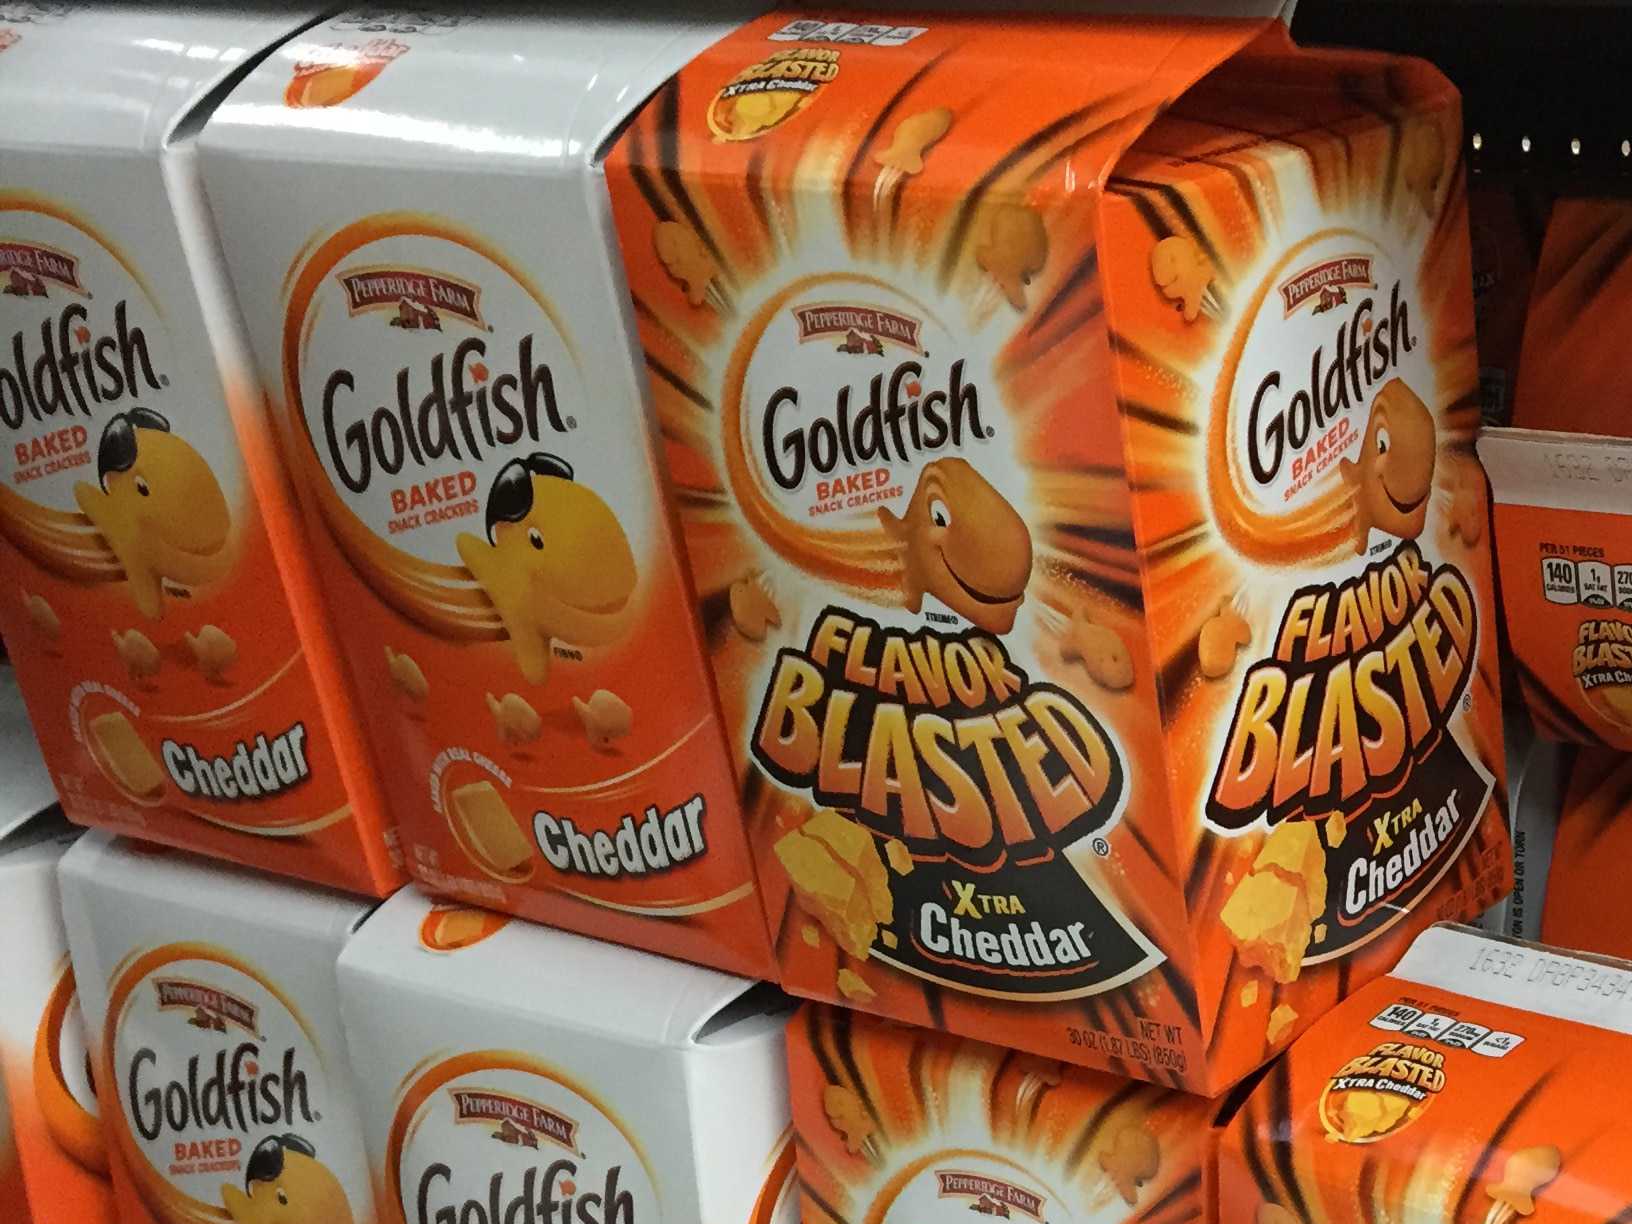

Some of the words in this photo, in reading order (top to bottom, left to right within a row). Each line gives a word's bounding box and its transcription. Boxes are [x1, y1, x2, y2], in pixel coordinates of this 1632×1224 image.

[430, 284, 470, 311] FARM
[0, 300, 161, 430] oldfish
[14, 425, 88, 465] BAKED
[1291, 417, 1350, 481] BAKED
[390, 471, 477, 513] BAKED
[816, 468, 890, 501] BAKED
[1547, 562, 1572, 584] 140
[1278, 551, 1429, 663] FLAVOR
[810, 613, 1022, 708] FLAVOR
[1582, 672, 1615, 689] XTRA
[1213, 569, 1474, 811] BLASTED
[162, 722, 310, 800] Cheddar
[757, 650, 1114, 850] BLASTED
[532, 796, 706, 878] Cheddar
[1345, 788, 1462, 916] Cheddar
[1513, 877, 1524, 905] OPEN
[920, 901, 1092, 966] Cheddar
[1333, 1055, 1447, 1093] BLASTED
[1334, 1077, 1375, 1091] XTRA
[1375, 1078, 1427, 1101] Cheddar
[532, 1107, 568, 1141] FARM
[174, 1138, 242, 1160] BAKED
[945, 1175, 1004, 1199] PEPPERIDGE
[1007, 1186, 1036, 1210] FARM
